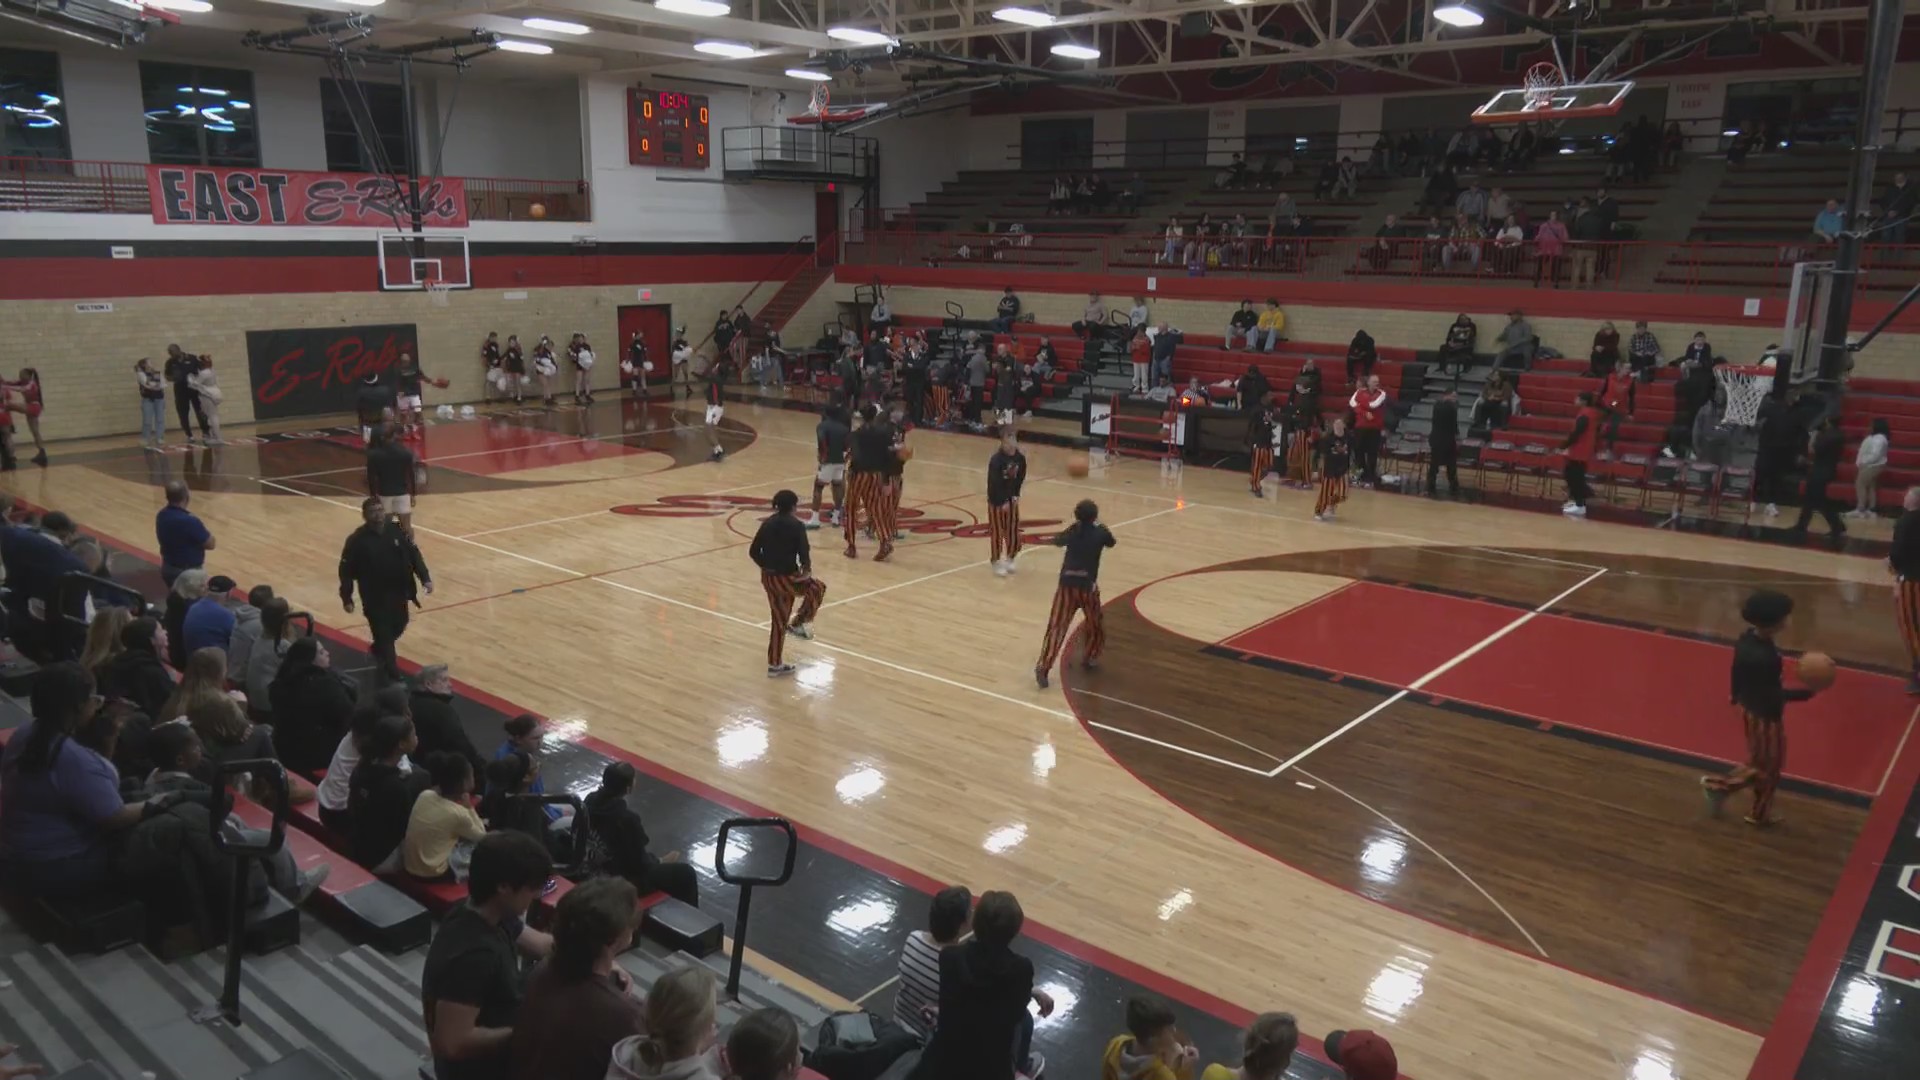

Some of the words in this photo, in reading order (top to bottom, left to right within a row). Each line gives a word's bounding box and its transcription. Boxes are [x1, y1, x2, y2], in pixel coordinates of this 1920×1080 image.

[659, 91, 689, 109] 10:04
[643, 100, 652, 118] 0
[700, 107, 708, 124] 0
[642, 138, 649, 151] 0
[697, 143, 704, 155] 0
[159, 168, 288, 223] EAST
